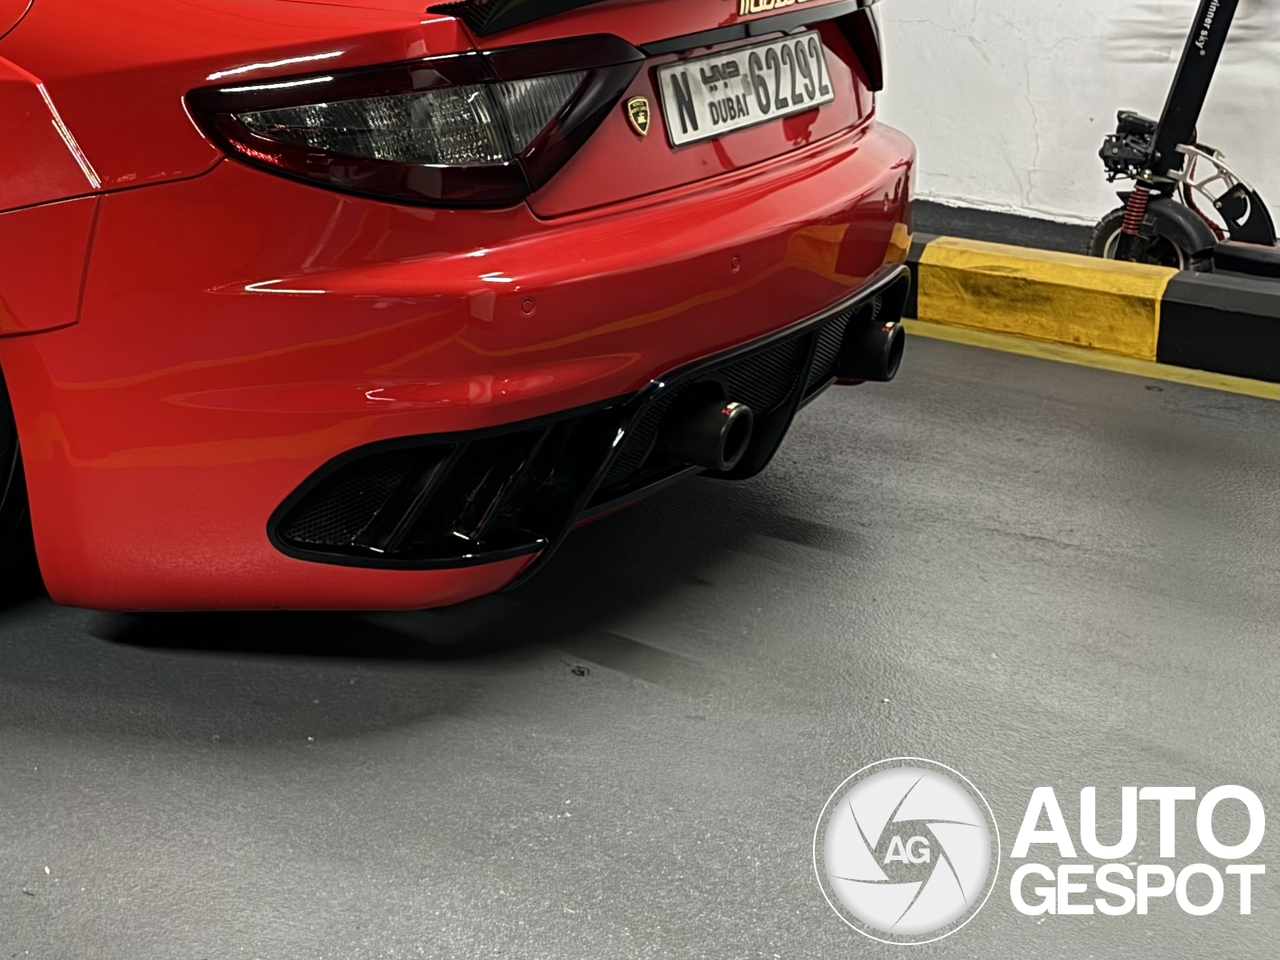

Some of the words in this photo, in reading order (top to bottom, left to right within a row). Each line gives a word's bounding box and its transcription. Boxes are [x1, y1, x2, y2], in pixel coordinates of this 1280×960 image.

[670, 70, 699, 135] N
[747, 36, 830, 115] 62292
[708, 92, 750, 126] DUBAI
